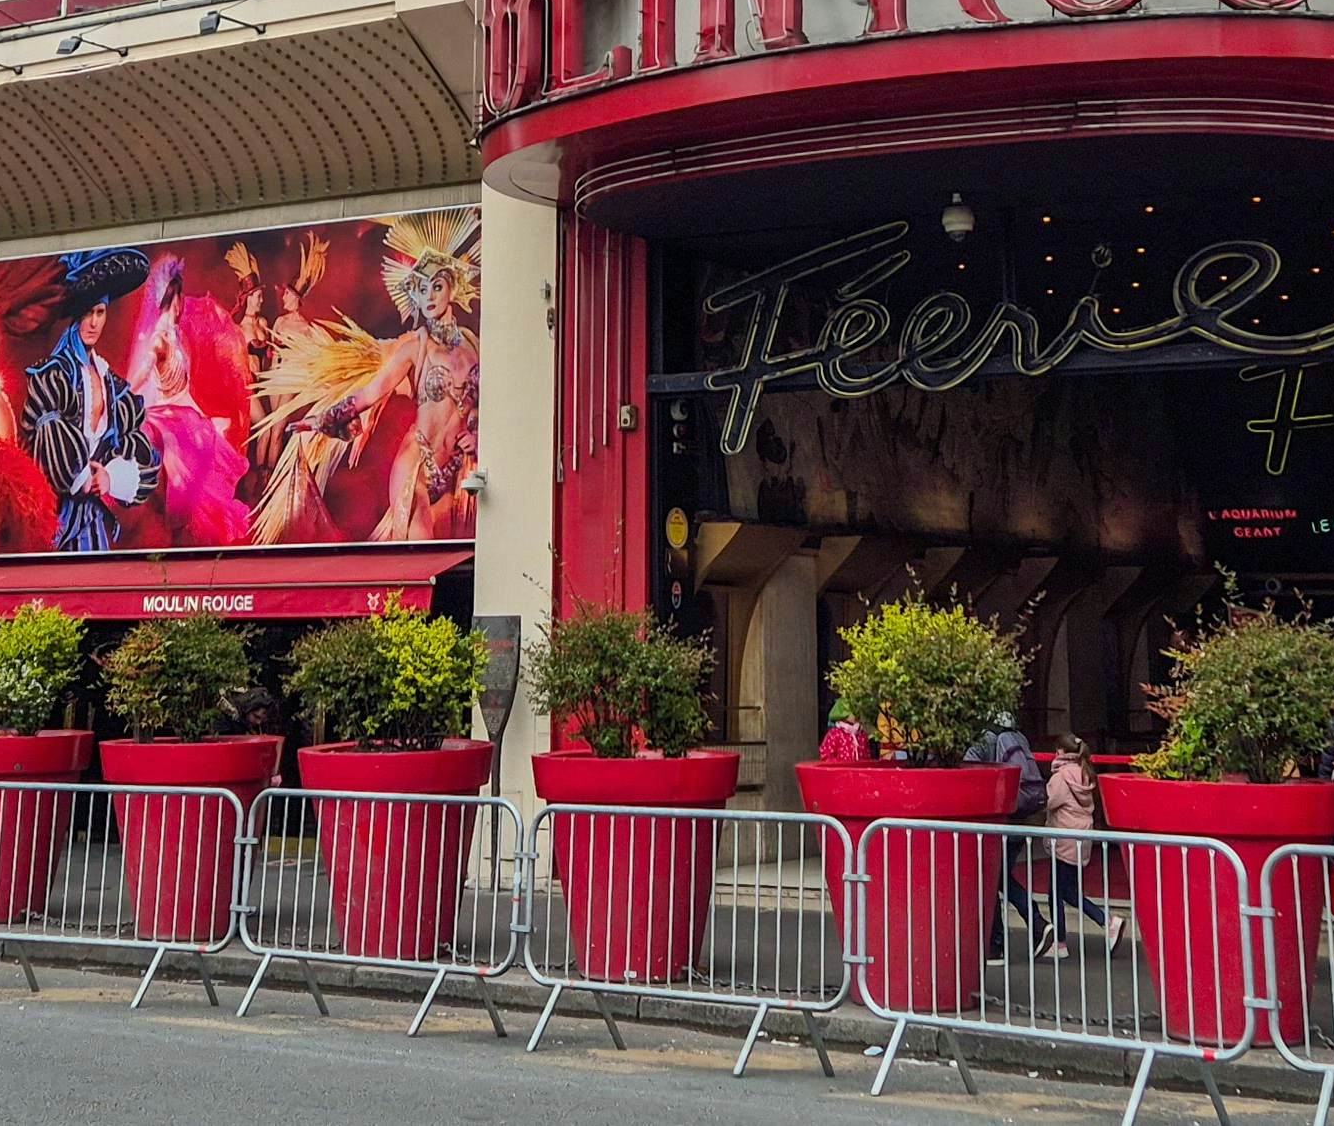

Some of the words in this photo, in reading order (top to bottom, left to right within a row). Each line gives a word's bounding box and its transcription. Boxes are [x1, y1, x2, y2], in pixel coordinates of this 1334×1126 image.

[1312, 518, 1331, 534] LE
[143, 595, 199, 612] MOULIN
[202, 594, 254, 612] ROUGE
